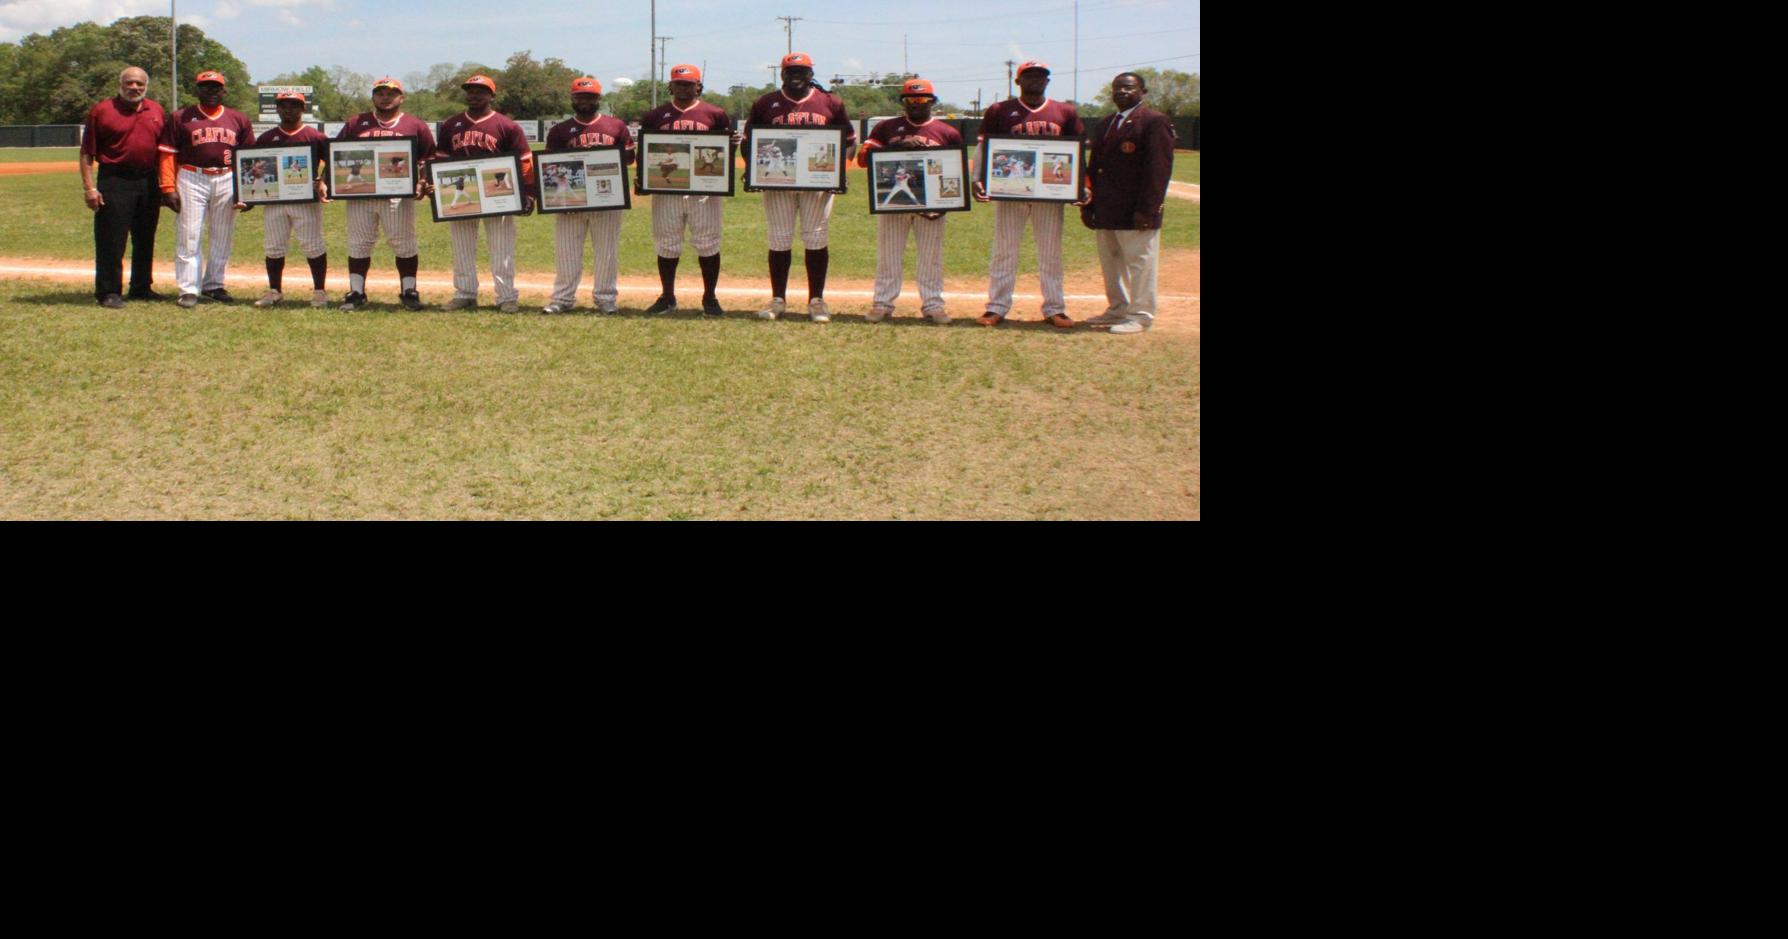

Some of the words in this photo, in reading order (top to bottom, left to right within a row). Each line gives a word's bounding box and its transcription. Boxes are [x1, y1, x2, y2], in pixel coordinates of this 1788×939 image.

[191, 126, 237, 146] CLAFLIN
[451, 130, 498, 152] CLAFLIN
[223, 149, 232, 166] 2
